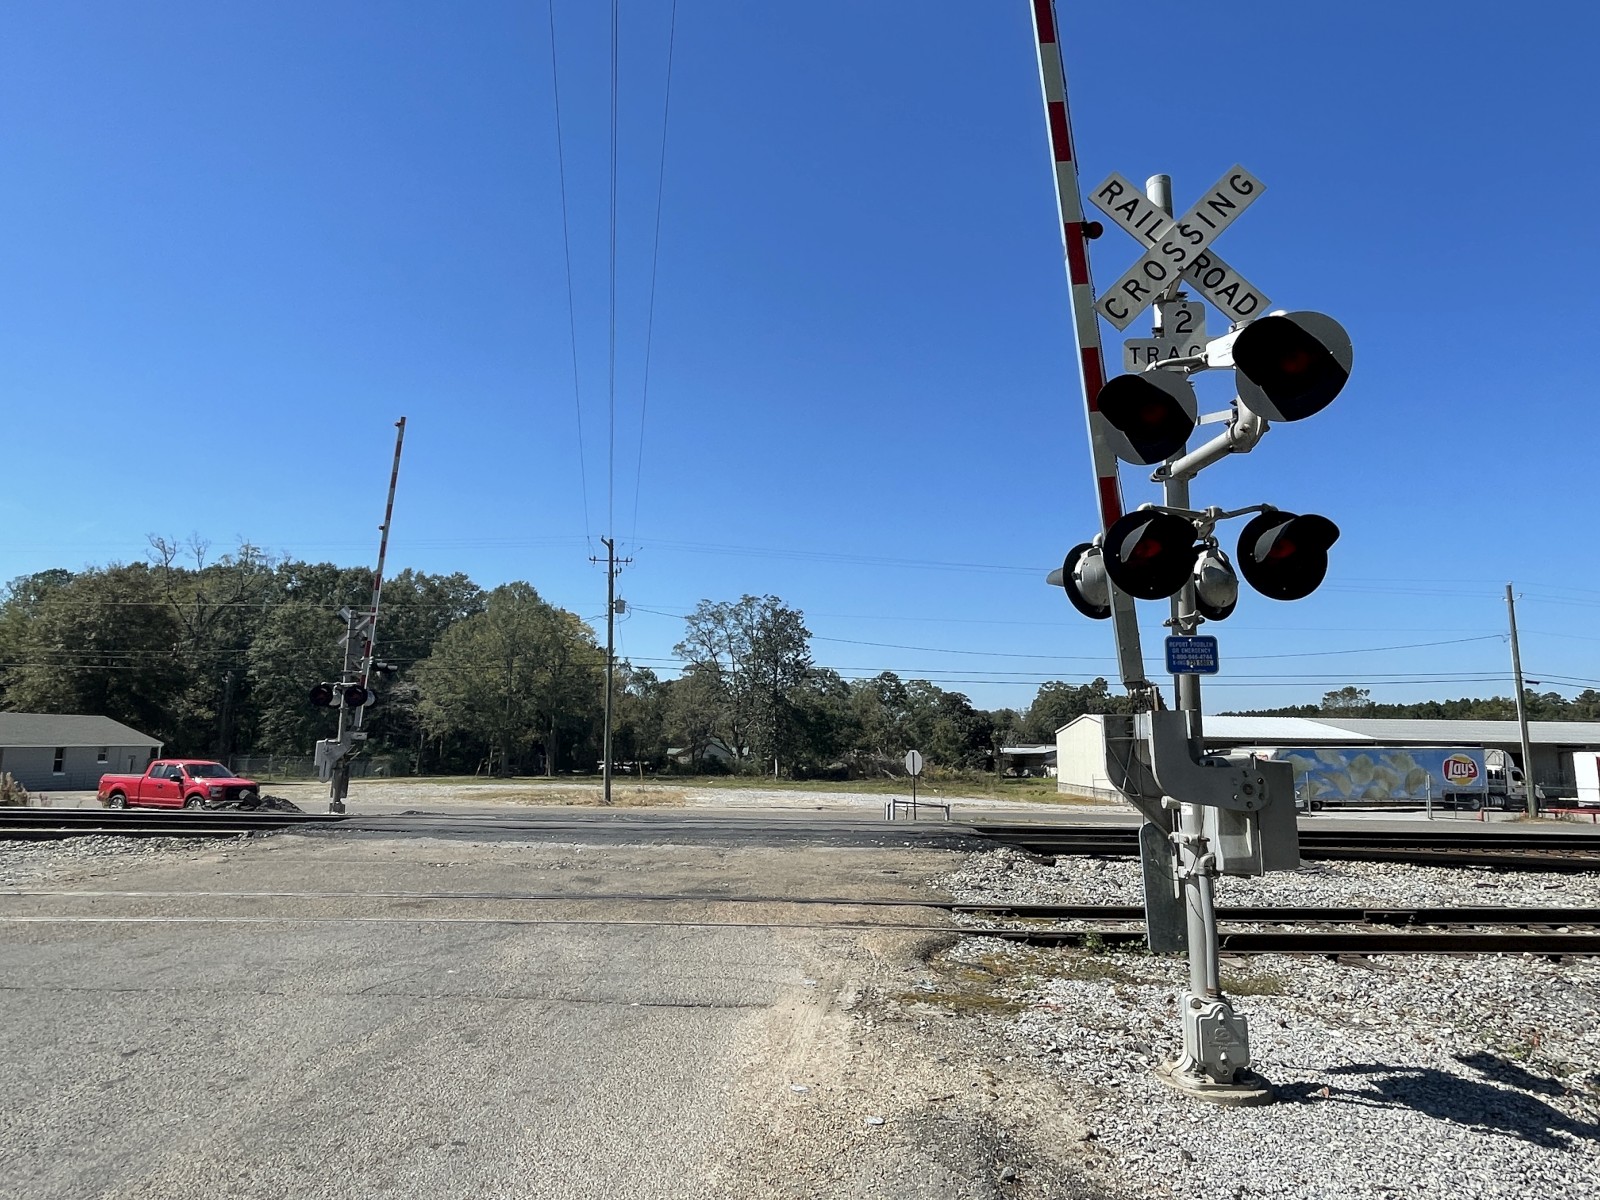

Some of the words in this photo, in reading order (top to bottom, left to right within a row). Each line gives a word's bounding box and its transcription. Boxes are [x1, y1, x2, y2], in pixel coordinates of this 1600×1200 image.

[1098, 180, 1164, 244] RAIL
[1183, 253, 1258, 316] ROAD
[1105, 174, 1254, 320] CROSSING
[1129, 345, 1201, 365] TRAC
[1174, 310, 1193, 334] 2
